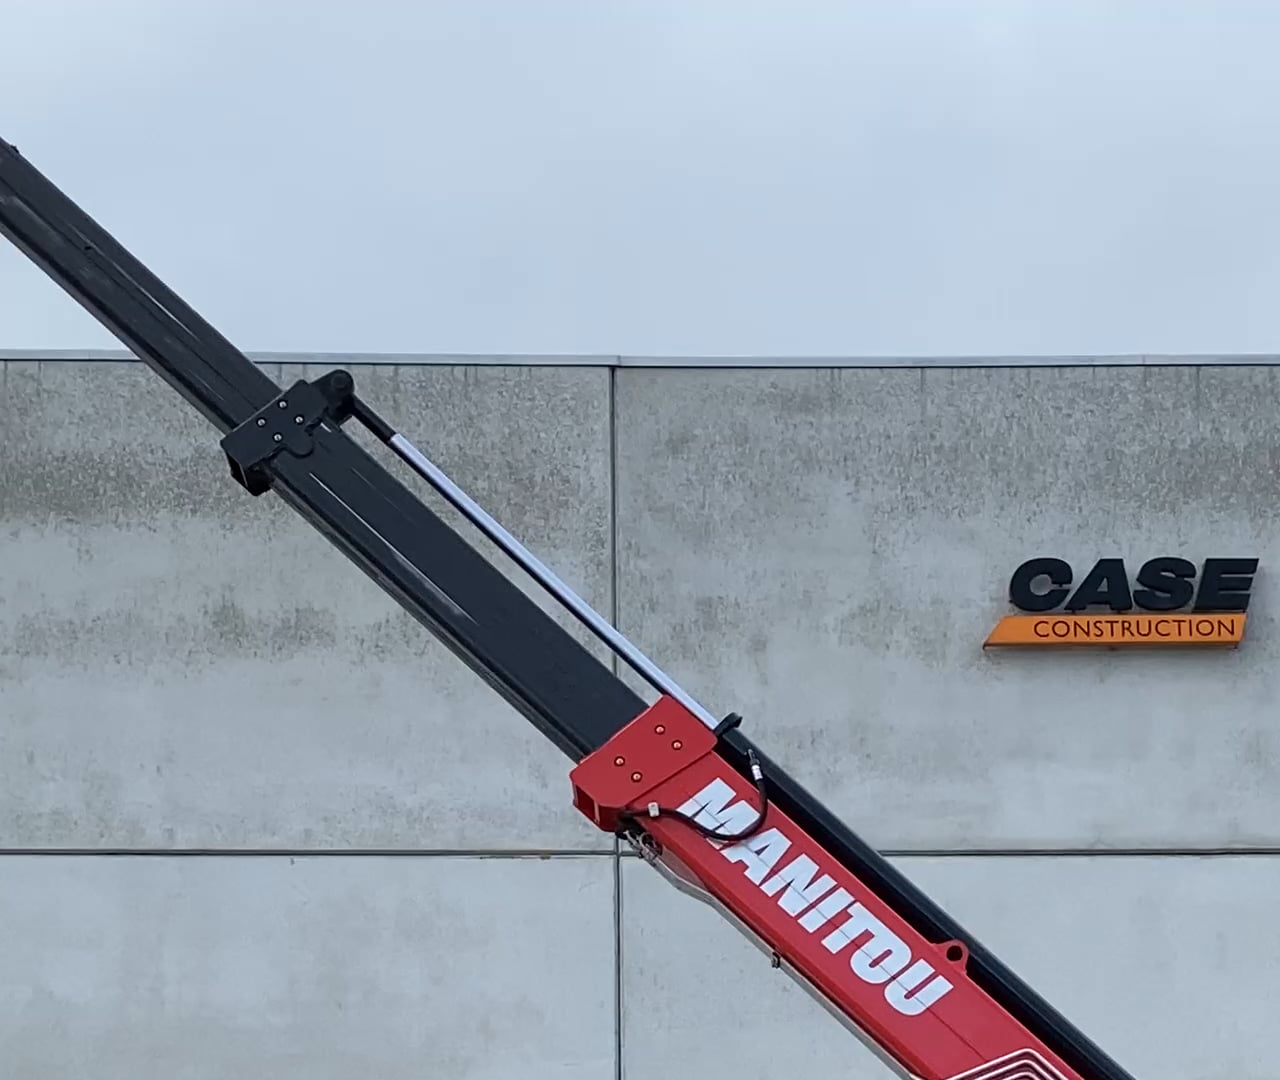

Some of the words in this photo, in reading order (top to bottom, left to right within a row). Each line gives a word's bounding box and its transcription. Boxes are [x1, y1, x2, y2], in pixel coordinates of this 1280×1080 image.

[1008, 556, 1260, 613] CASE
[1032, 618, 1236, 639] CONSTRUCTION
[675, 776, 954, 1017] MANITOU
